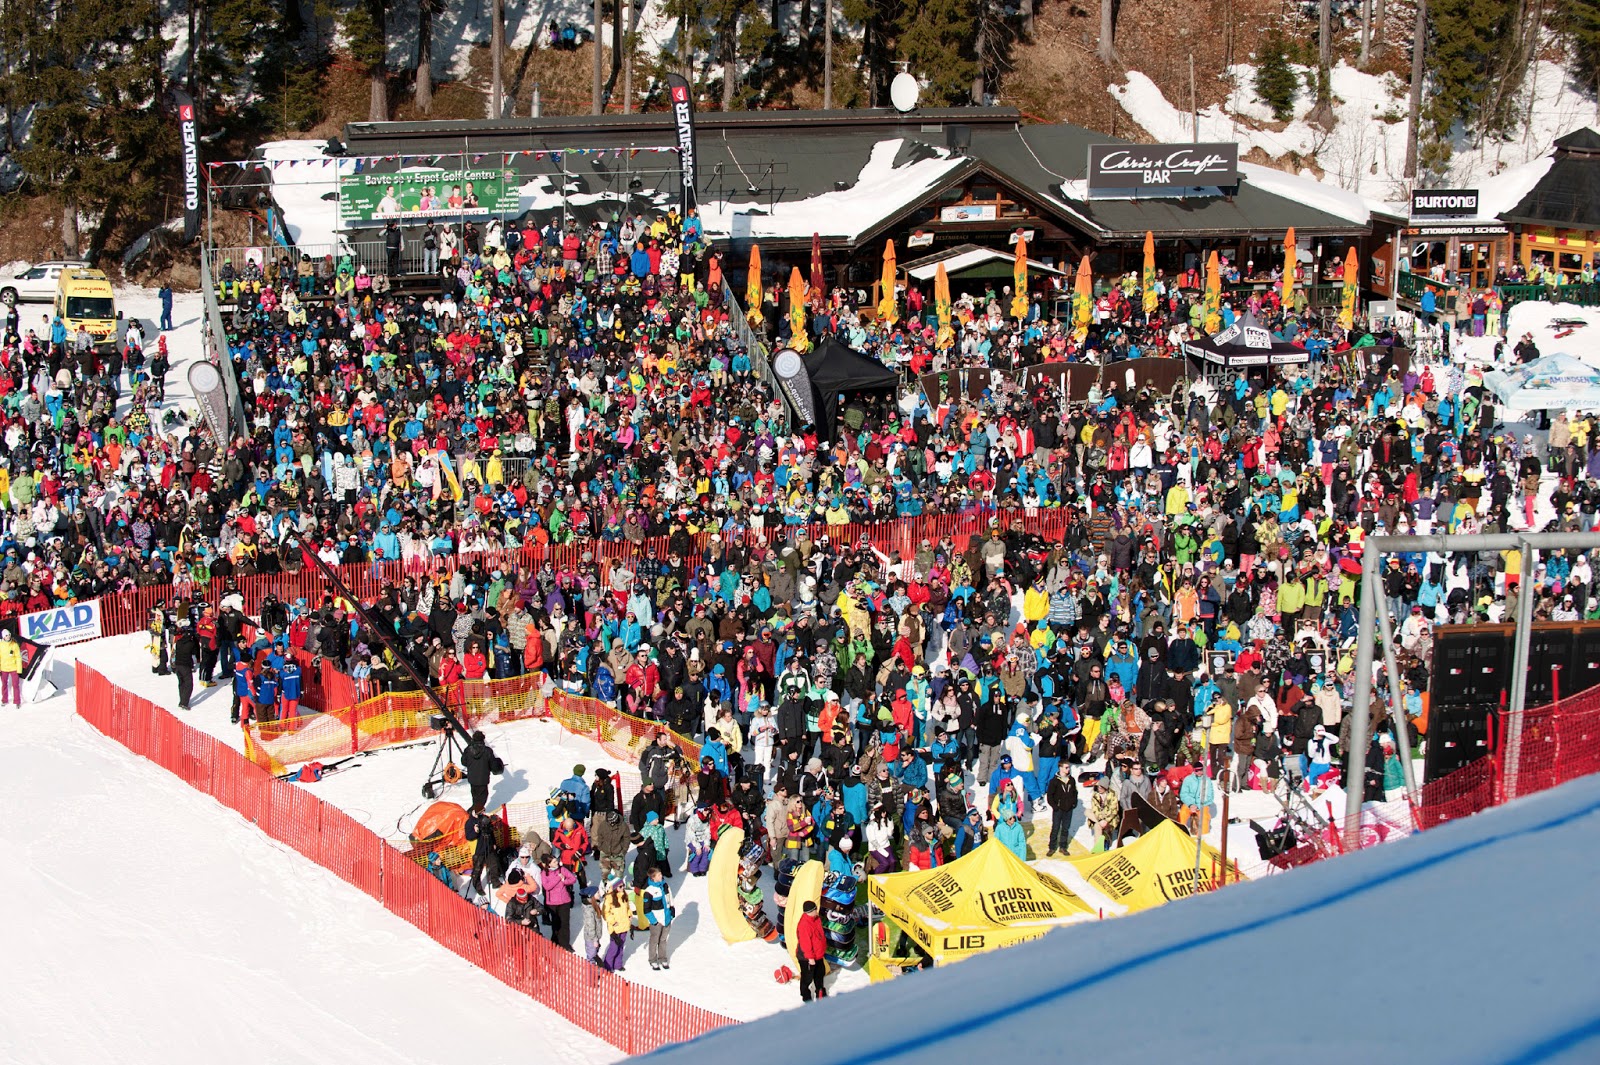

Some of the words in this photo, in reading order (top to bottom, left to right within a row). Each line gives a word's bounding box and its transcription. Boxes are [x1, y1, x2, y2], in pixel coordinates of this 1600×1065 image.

[676, 102, 694, 187] QUIKSILVER
[182, 121, 198, 210] QUIKSILVER
[1100, 150, 1152, 170] Chris
[1165, 150, 1228, 175] Craft
[365, 174, 392, 185] Bavte
[394, 176, 404, 184] se
[406, 175, 412, 183] v
[414, 172, 440, 185] Erpet
[442, 171, 462, 182] Golf
[464, 170, 495, 182] Centru
[1143, 170, 1170, 184] BAR
[1415, 196, 1466, 208] BURTON
[1421, 227, 1474, 235] SNOWBOARD
[1474, 226, 1508, 234] SCHOOL
[28, 605, 93, 636] KAD
[1112, 855, 1140, 881] TRUST
[1166, 868, 1209, 885] TRUST
[936, 873, 963, 897] TRUST
[1099, 866, 1135, 897] MERVIN
[870, 880, 886, 904] LIB
[921, 882, 955, 912] MERVIN
[989, 888, 1032, 904] TRUST
[994, 901, 1054, 916] MERVIN
[998, 912, 1057, 922] MANUFACTURING
[944, 935, 985, 950] LIB
